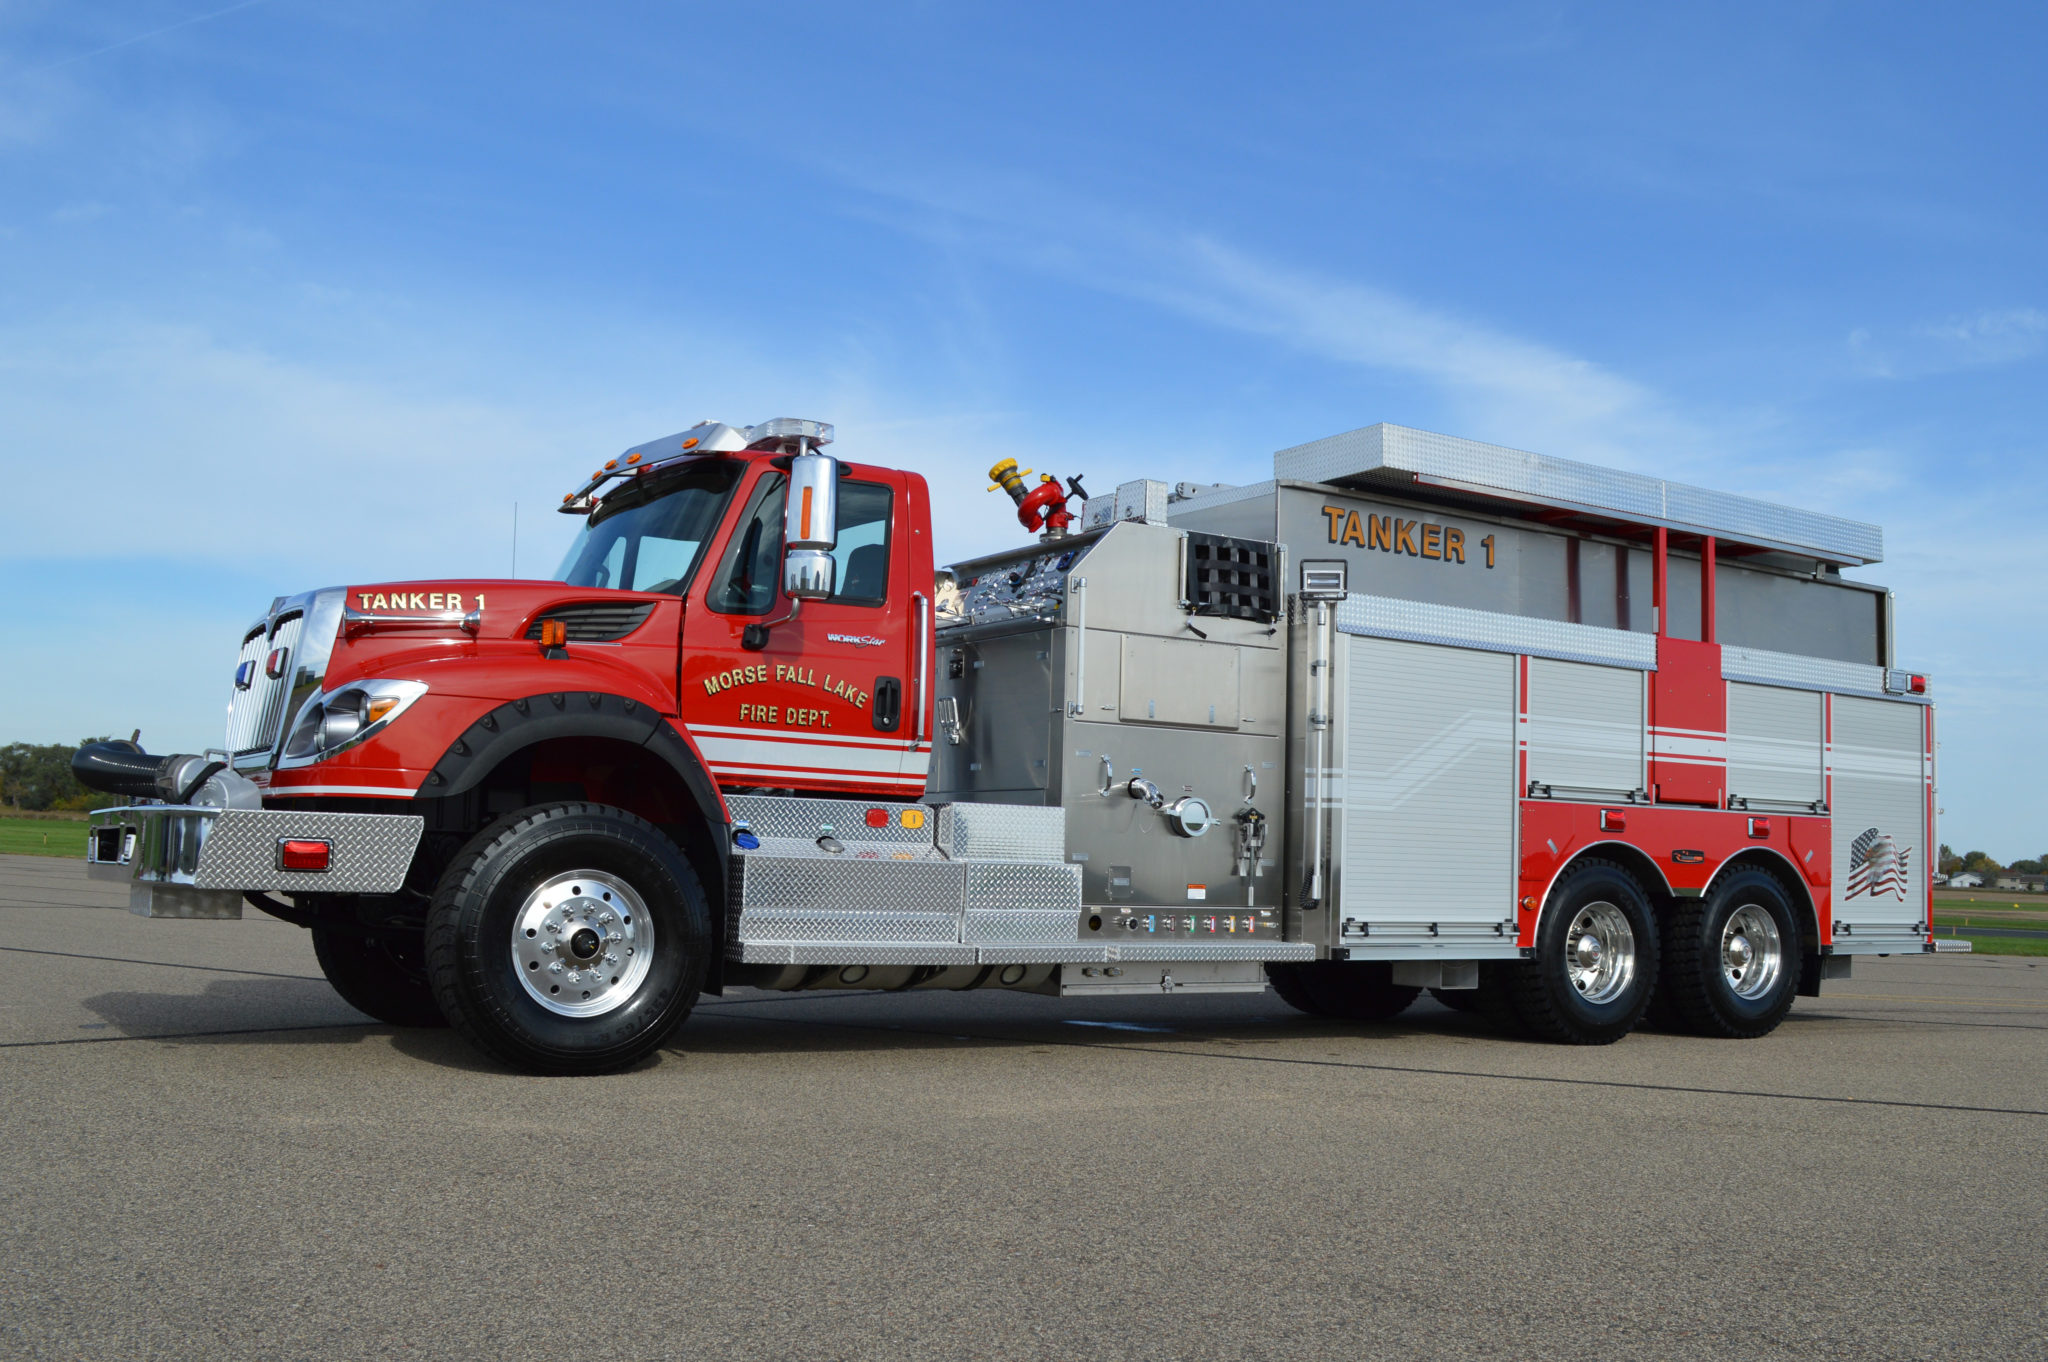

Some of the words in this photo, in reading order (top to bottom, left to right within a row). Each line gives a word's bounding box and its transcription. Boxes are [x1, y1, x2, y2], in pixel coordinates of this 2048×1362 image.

[1322, 505, 1465, 564] TANKER
[1481, 534, 1495, 569] 1
[357, 592, 462, 610] TANKER
[474, 594, 485, 610] 1
[703, 664, 768, 696] MORSE
[776, 664, 816, 687] FALL
[823, 674, 869, 709] LAKE
[739, 703, 779, 723] FIRE
[786, 707, 832, 728] DEPT.
